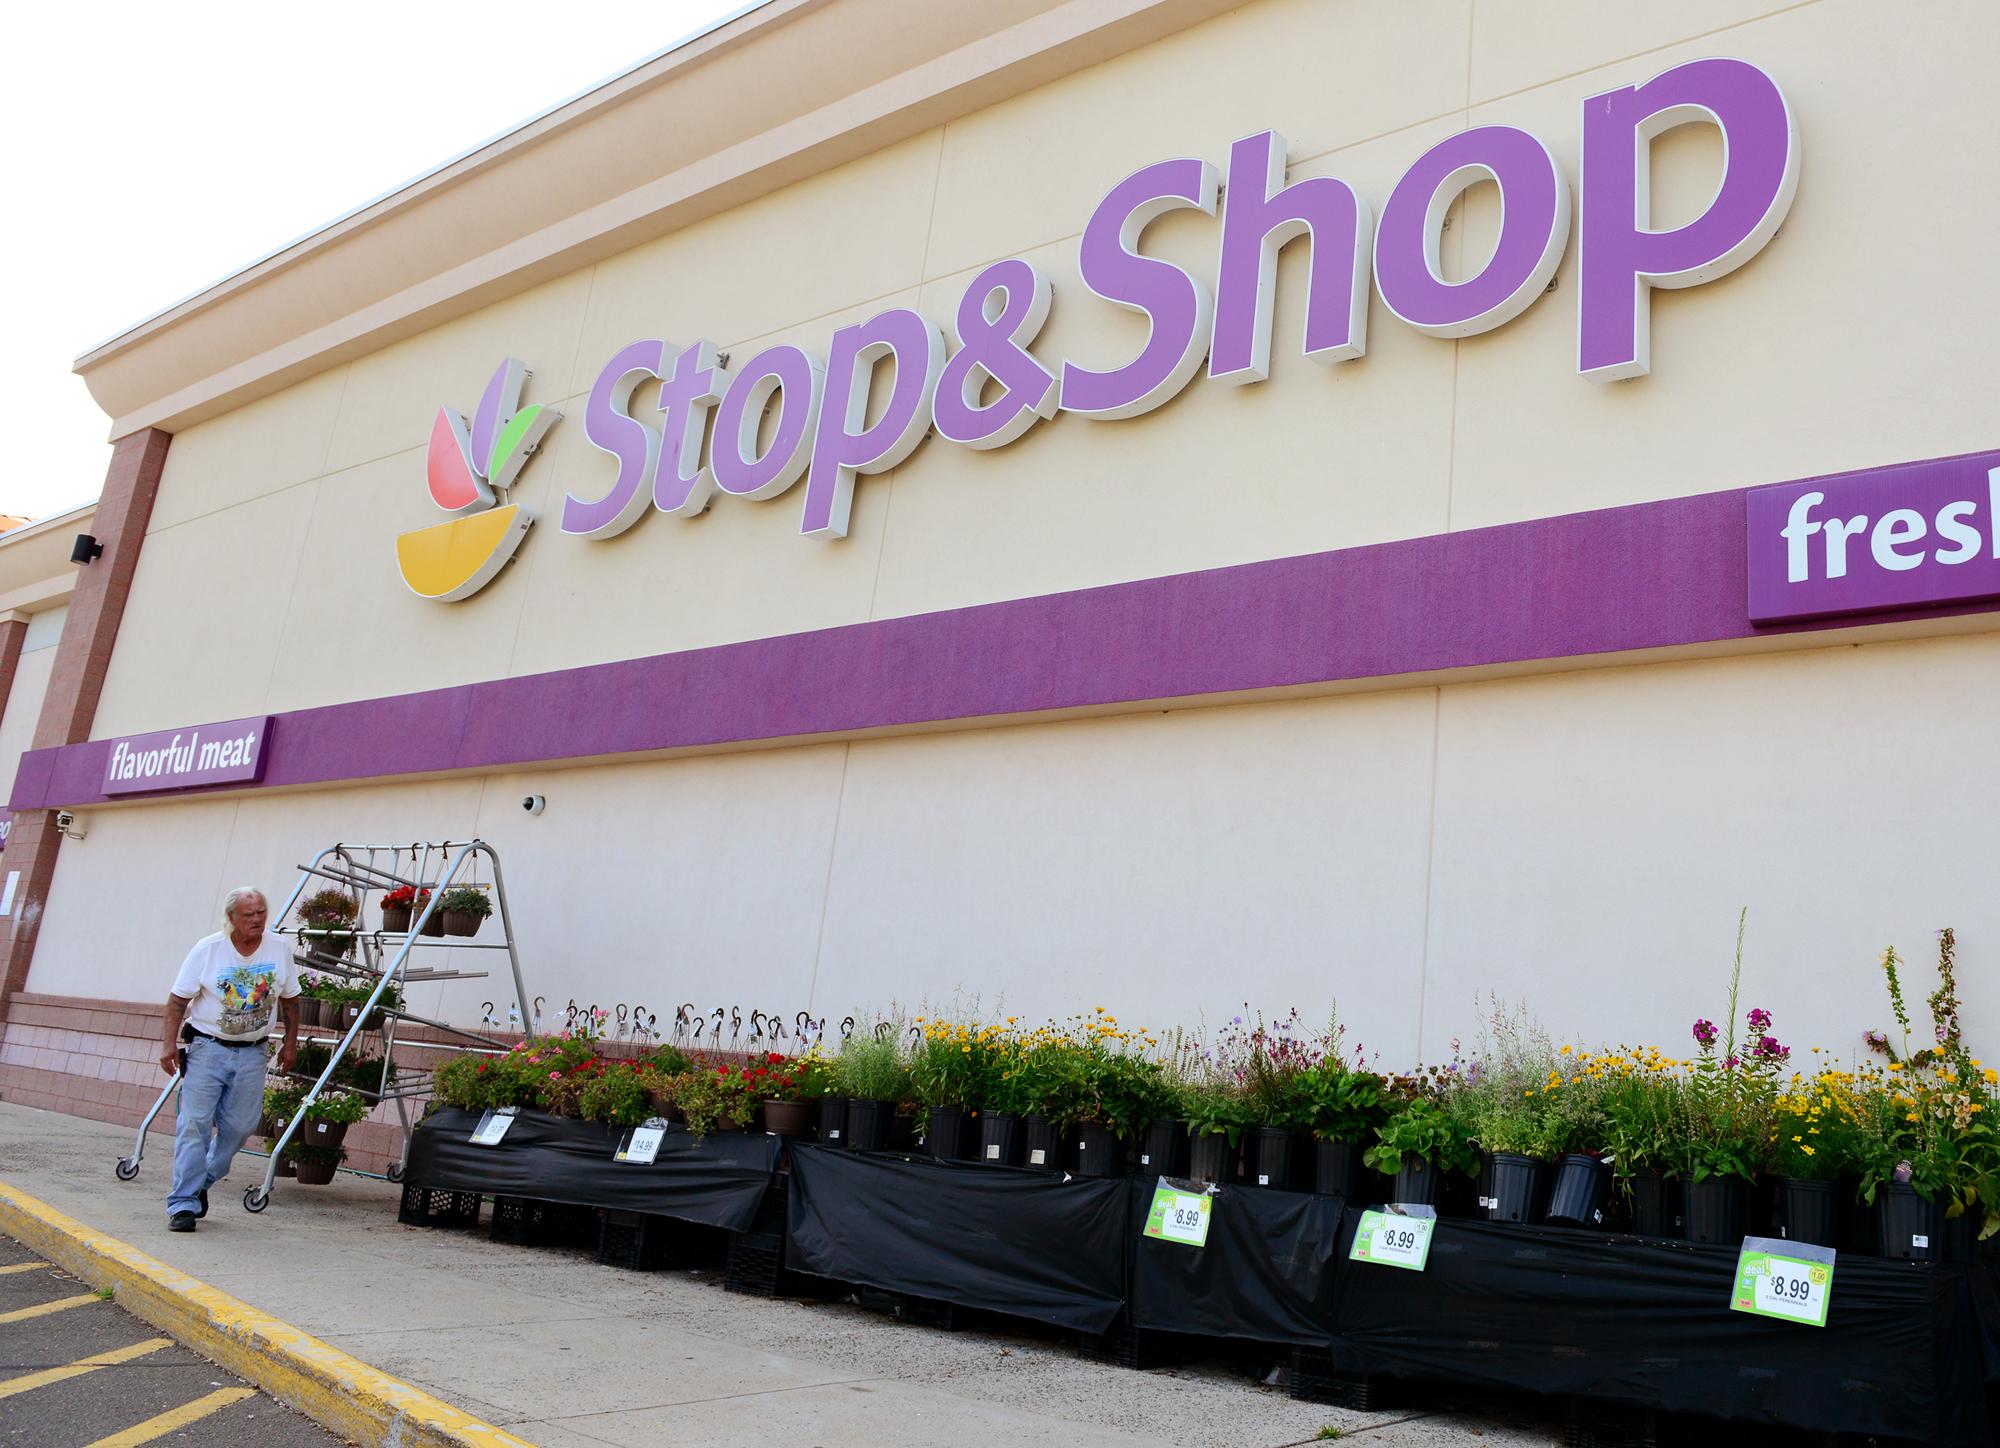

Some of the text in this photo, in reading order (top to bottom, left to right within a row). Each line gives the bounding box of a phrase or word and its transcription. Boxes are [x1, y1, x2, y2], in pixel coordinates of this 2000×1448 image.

[110, 731, 255, 780] flavorful meat
[1175, 1209, 1198, 1227] $8.99
[1384, 1229, 1414, 1249] $8.99
[1770, 1276, 1810, 1300] $8.99
